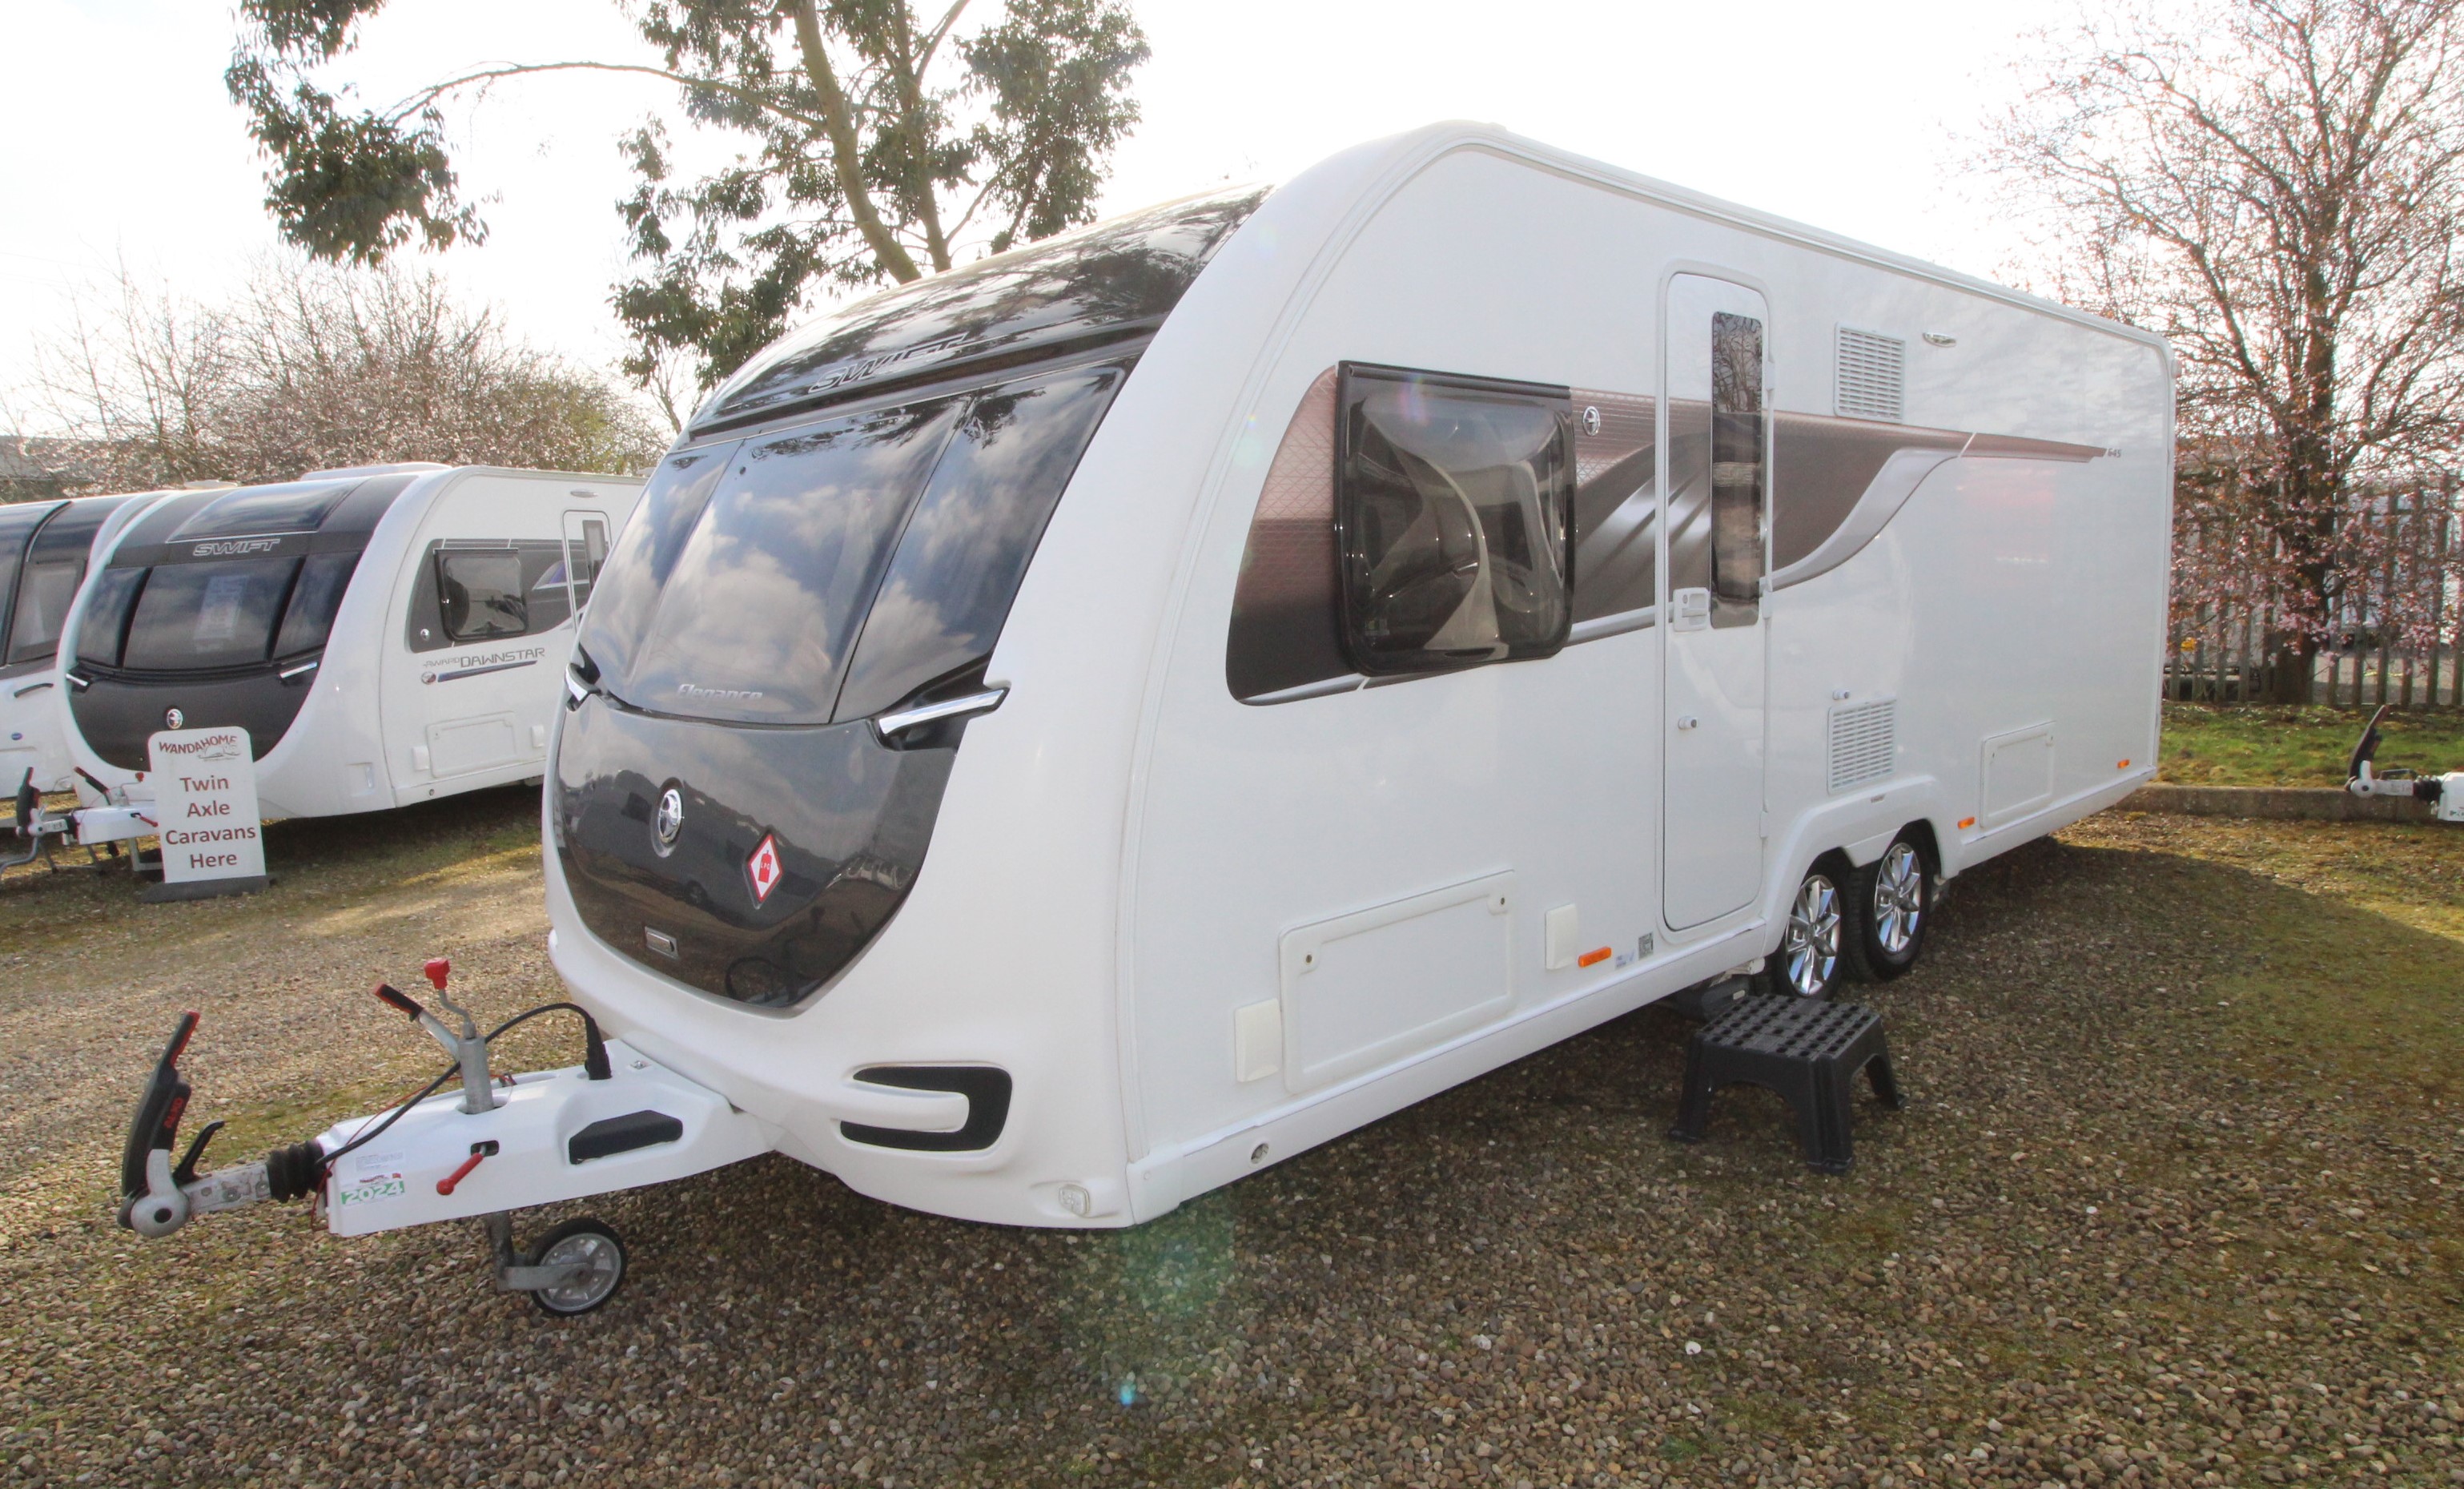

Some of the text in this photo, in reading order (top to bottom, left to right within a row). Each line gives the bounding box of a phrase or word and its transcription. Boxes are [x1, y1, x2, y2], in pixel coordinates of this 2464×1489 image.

[808, 332, 970, 393] SWIFT
[192, 538, 281, 557] SWIFT
[460, 647, 545, 668] DAWNSTAR
[159, 734, 238, 755] WANDAHOME
[179, 775, 230, 792] Twin
[187, 800, 231, 818] Axle
[165, 827, 256, 845] Caravans
[190, 853, 238, 869] Here
[343, 1181, 404, 1205] 2024
